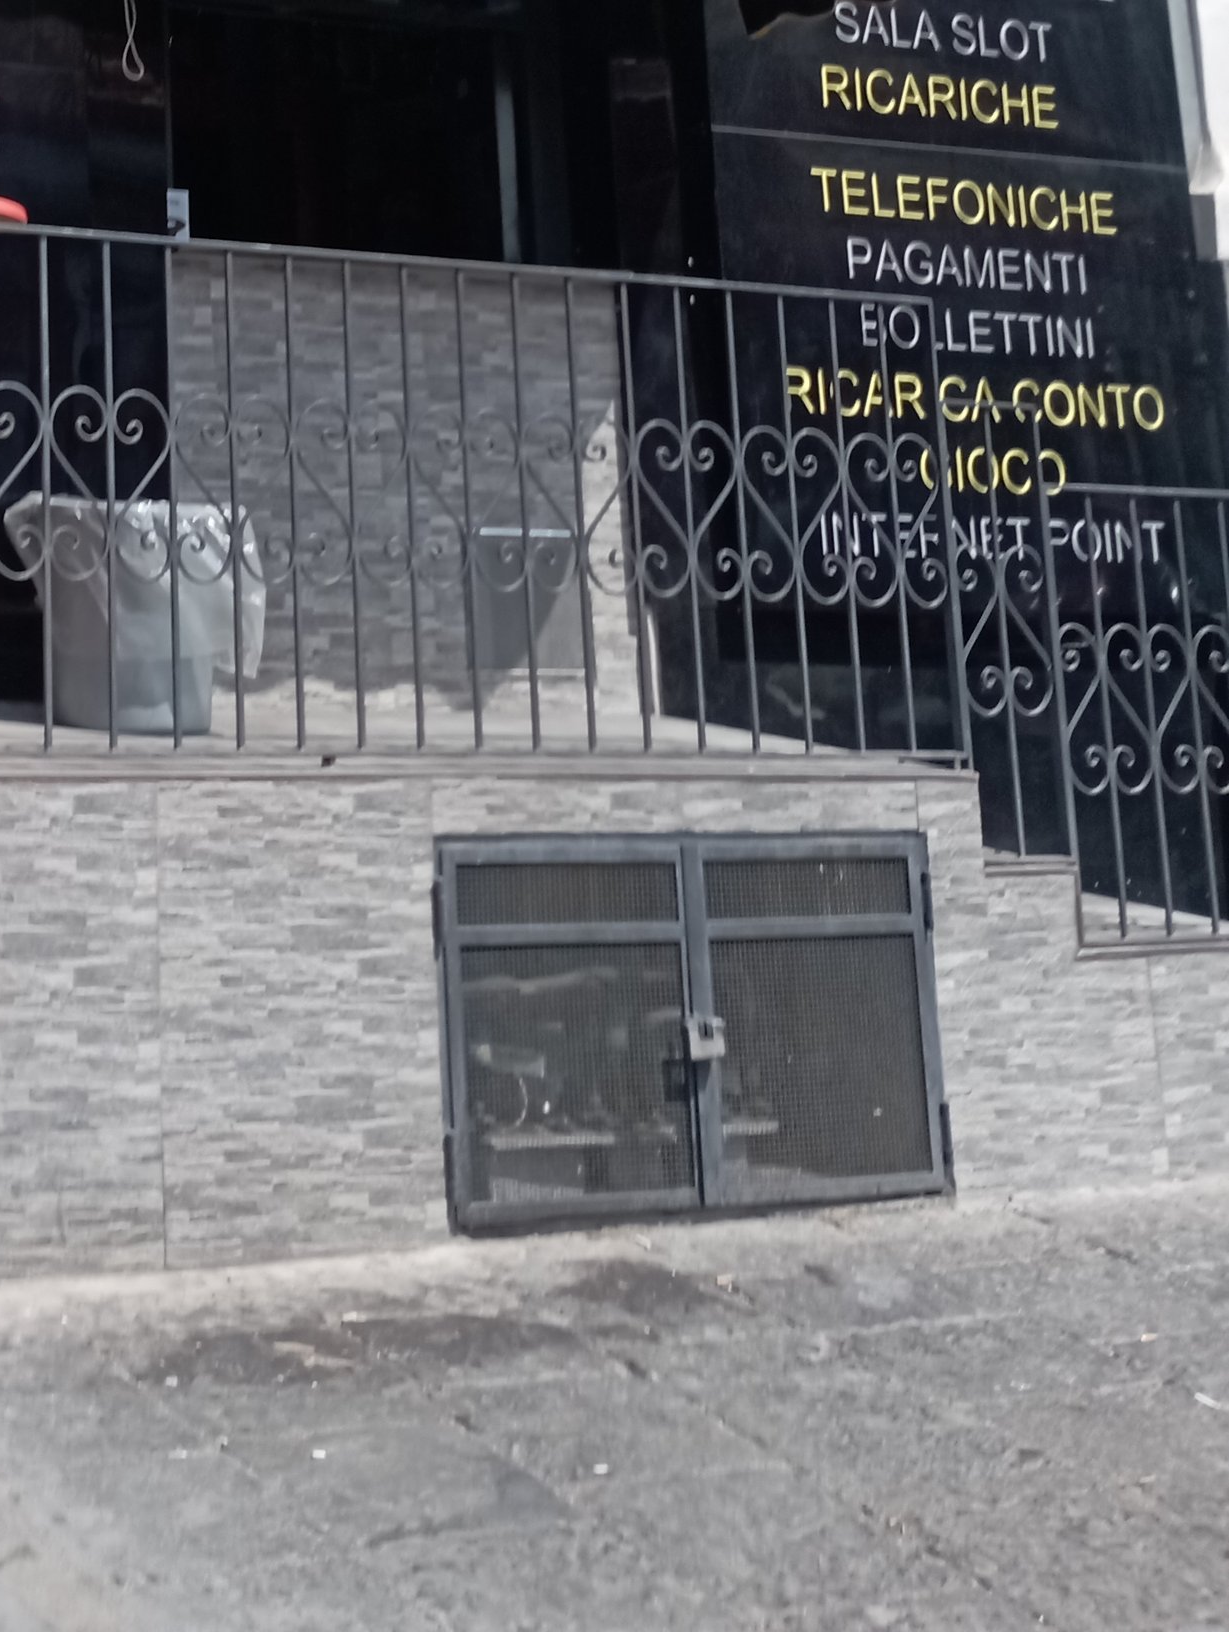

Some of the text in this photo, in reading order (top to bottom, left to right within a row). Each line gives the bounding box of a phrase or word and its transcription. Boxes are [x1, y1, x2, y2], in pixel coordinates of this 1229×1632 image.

[833, 1, 1052, 63] SALA SLOT
[820, 64, 1060, 130] RICARICHE
[810, 166, 1118, 236] TELEFONICHE
[846, 236, 1088, 295] PAGAMENTI
[860, 302, 1096, 360] BOLETTINI
[785, 365, 1165, 432] RICARCA CONTO
